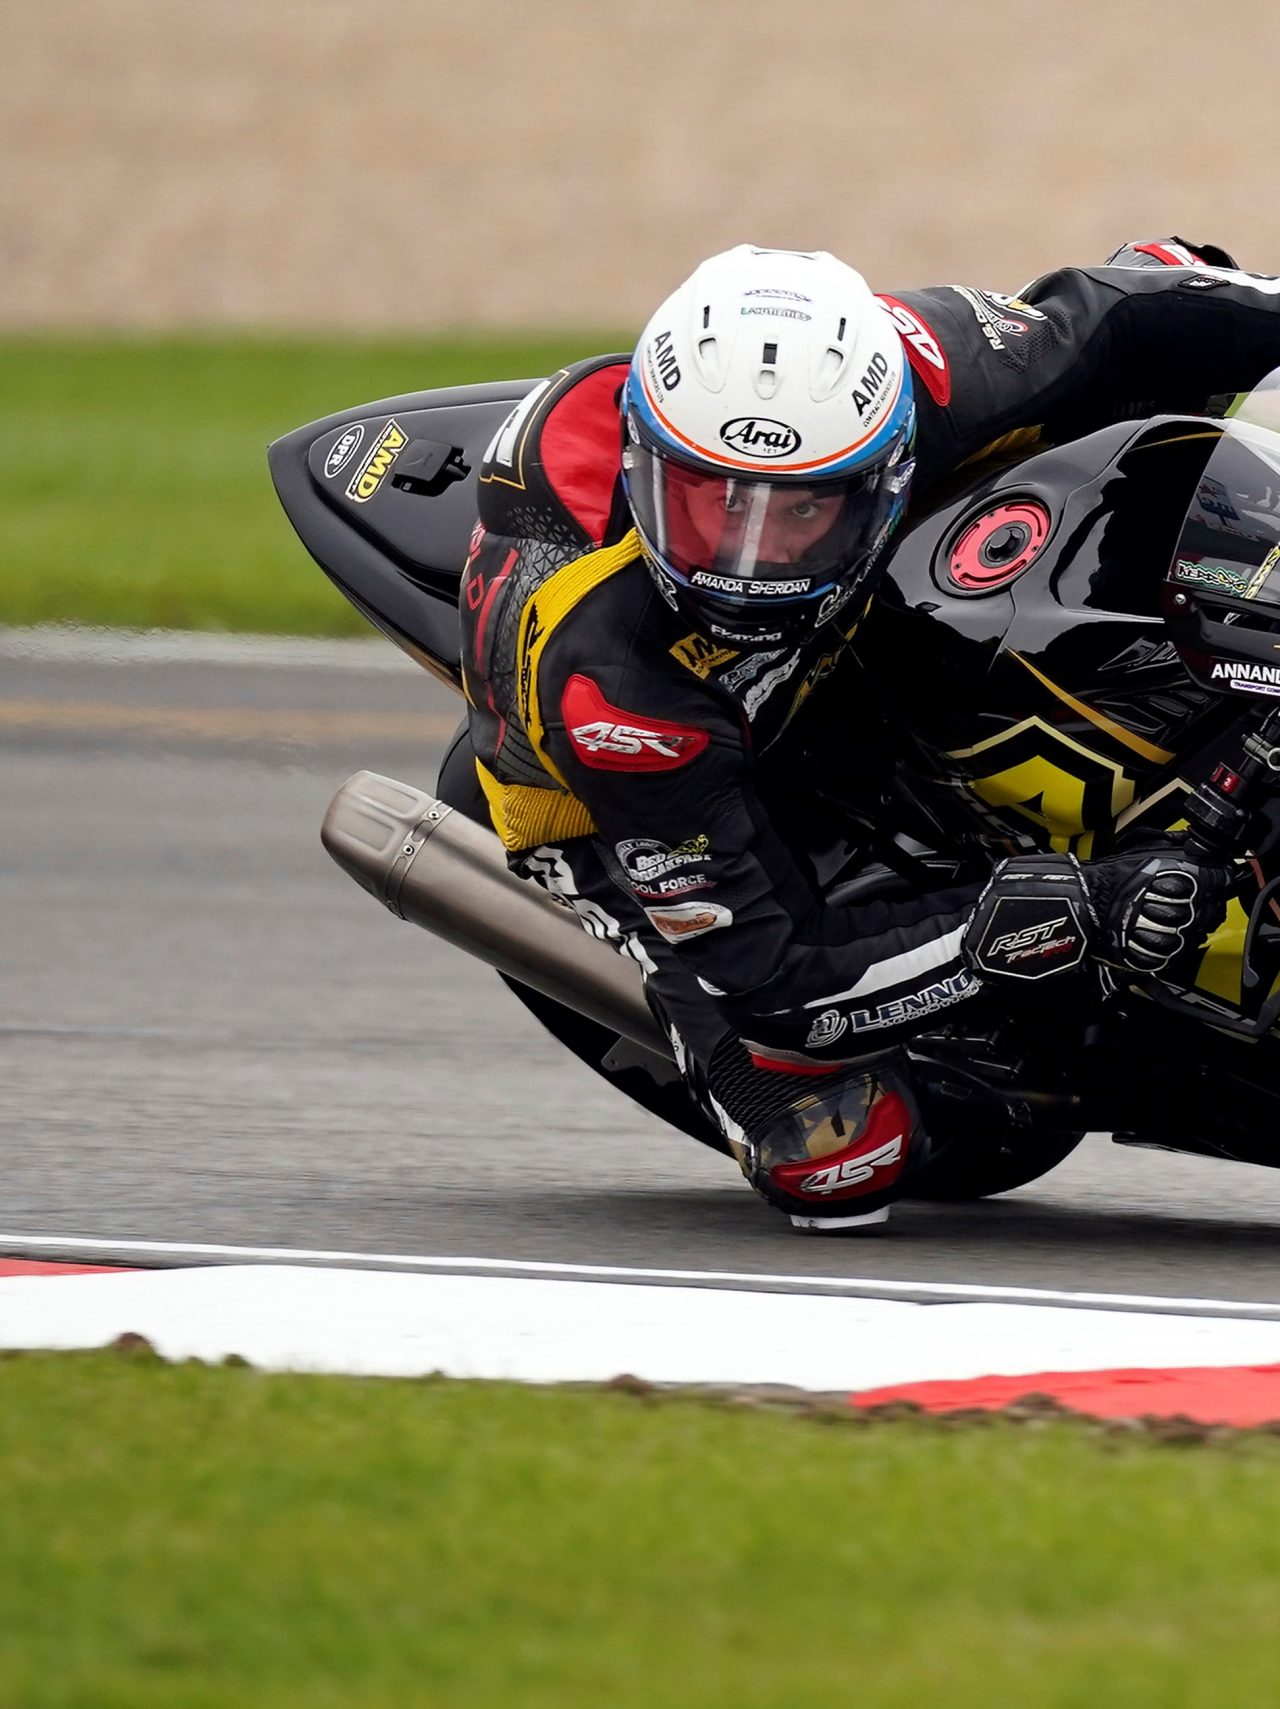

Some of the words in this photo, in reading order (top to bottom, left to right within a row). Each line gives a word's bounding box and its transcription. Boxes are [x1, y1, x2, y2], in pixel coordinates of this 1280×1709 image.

[654, 330, 682, 392] AMD
[851, 352, 888, 417] AMD
[329, 435, 355, 466] DPR
[725, 421, 791, 449] Arai
[358, 427, 404, 497] AMD
[691, 572, 744, 593] AMANDA
[748, 578, 811, 595] SHERIDAN
[659, 874, 707, 893] FORCE
[987, 916, 1069, 957] RST
